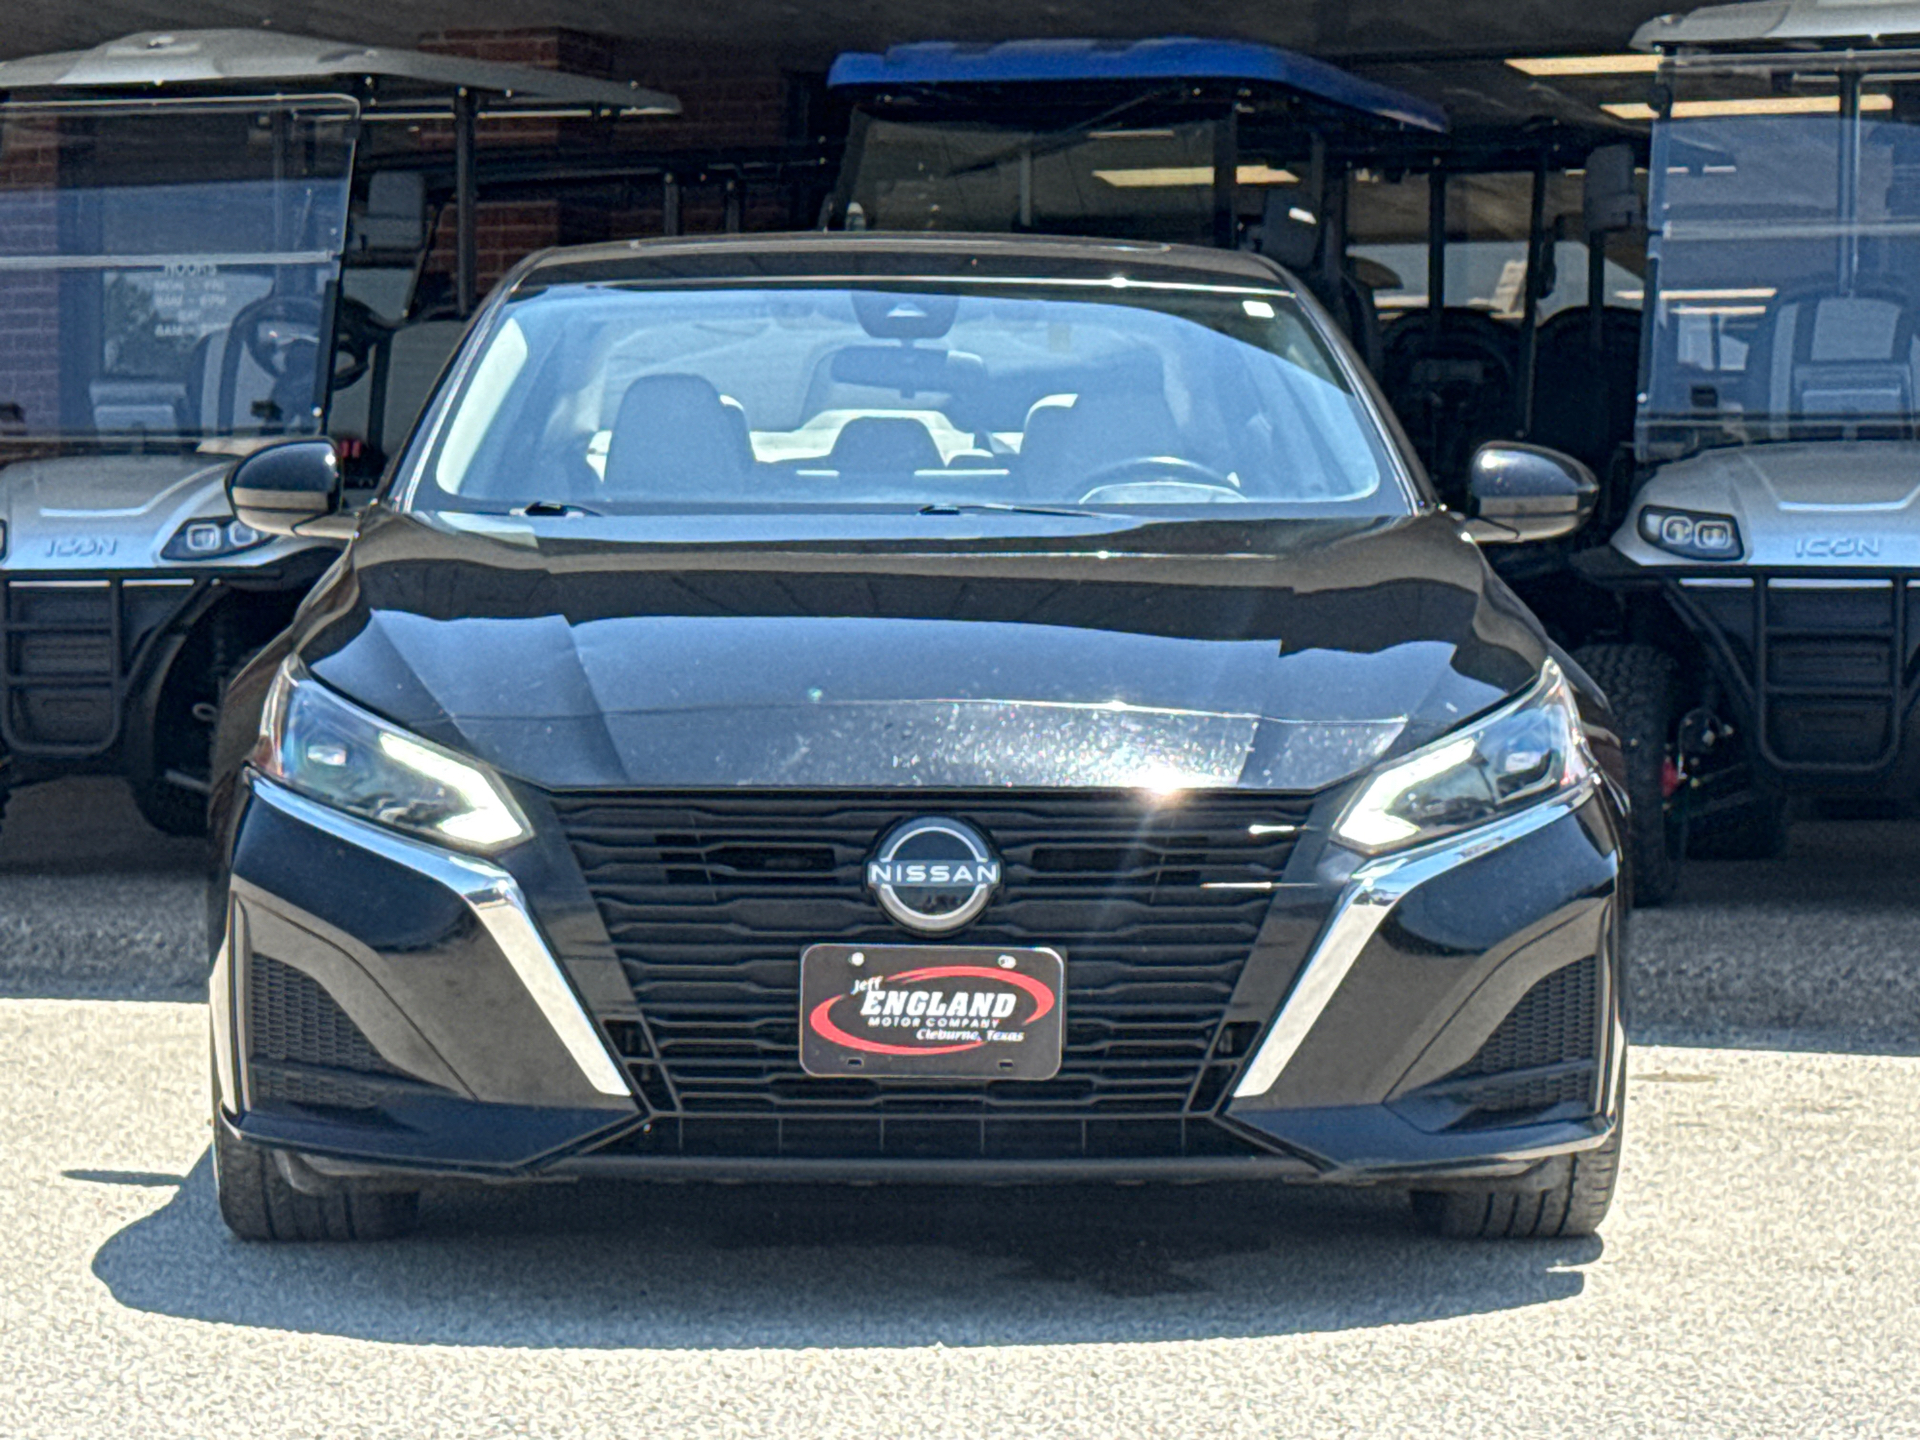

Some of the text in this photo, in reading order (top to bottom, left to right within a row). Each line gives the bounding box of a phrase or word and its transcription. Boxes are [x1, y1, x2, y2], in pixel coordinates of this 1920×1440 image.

[44, 538, 118, 557] ICON
[1794, 538, 1880, 558] ICON
[871, 864, 998, 882] NISSAN
[850, 976, 884, 995] Jeff
[860, 990, 1017, 1018] ENGLAND
[868, 1016, 1000, 1029] MOTOR COMPANY
[916, 1028, 1025, 1043] Cleburne, Texas
